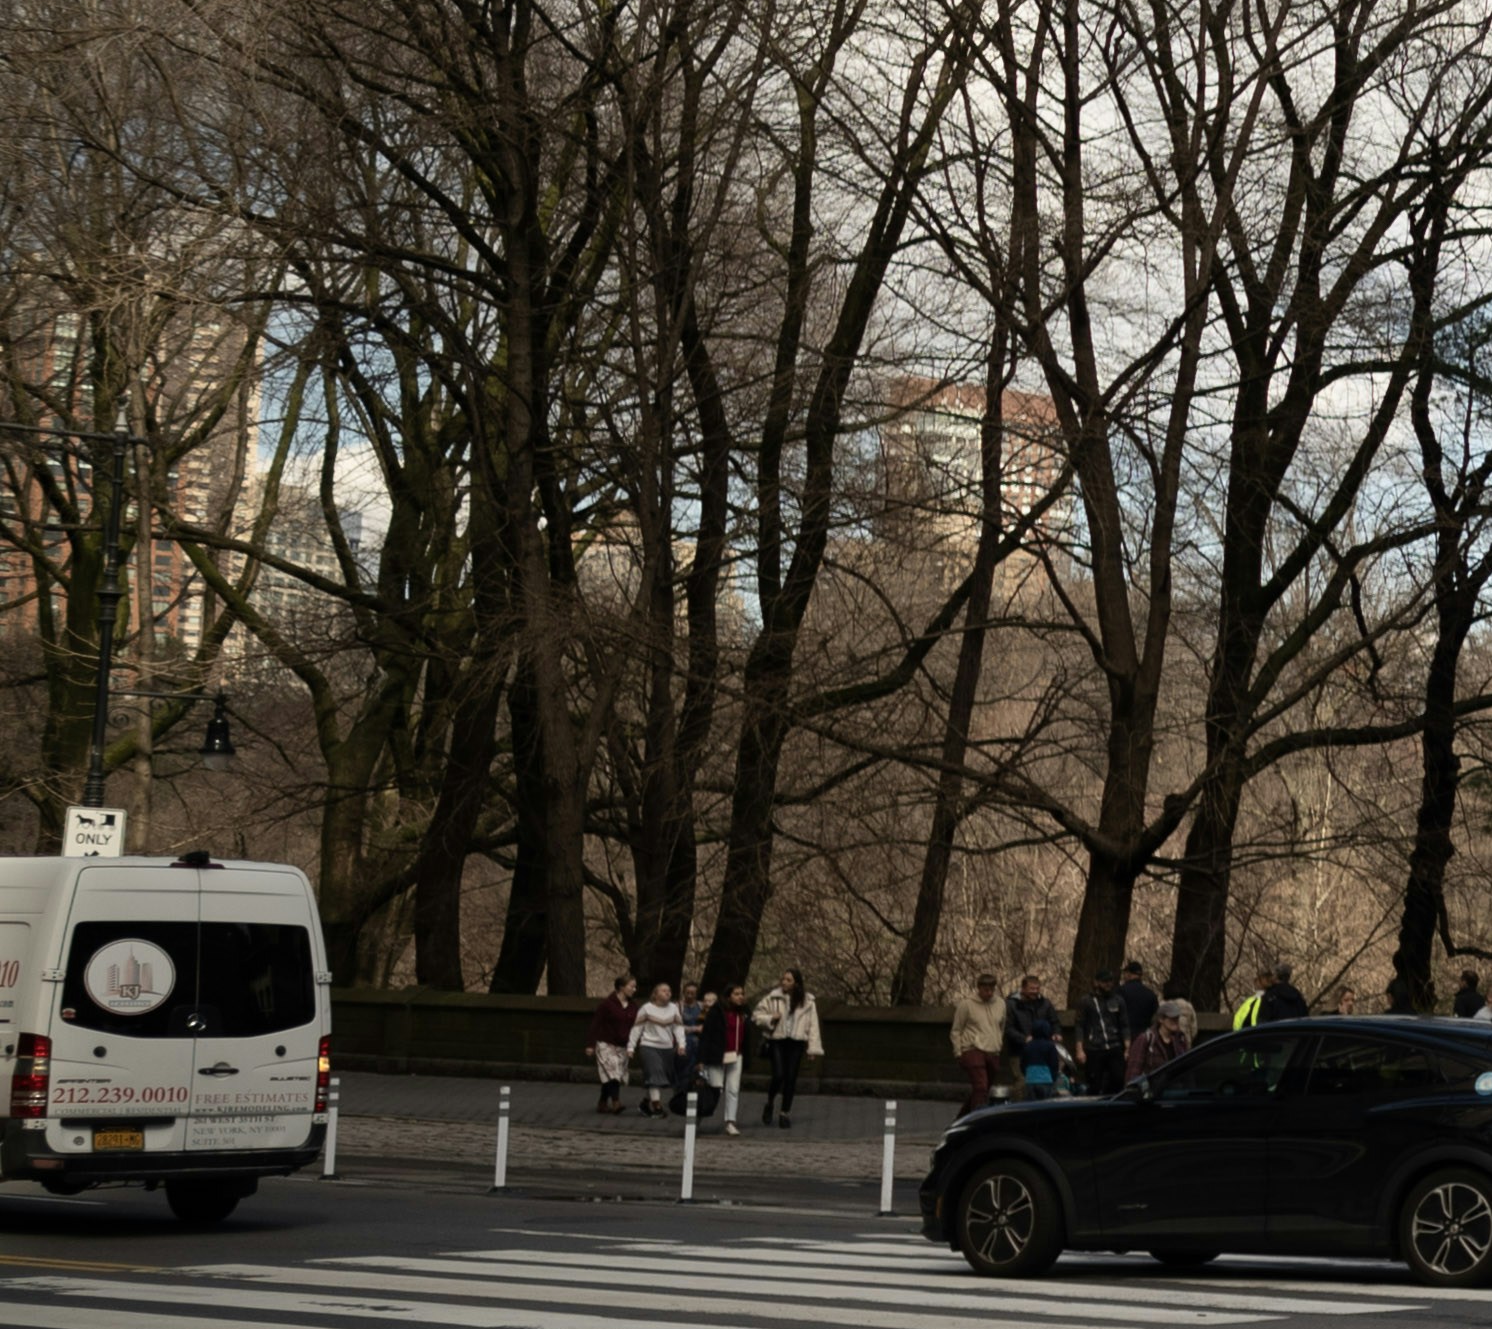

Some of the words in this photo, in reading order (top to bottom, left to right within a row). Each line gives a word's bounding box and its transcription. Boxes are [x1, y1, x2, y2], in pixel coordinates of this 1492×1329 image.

[75, 833, 112, 845] ONLY
[52, 1087, 188, 1104] 212.239.0010
[195, 1094, 230, 1104] FREE
[235, 1092, 309, 1104] ESTIMATES
